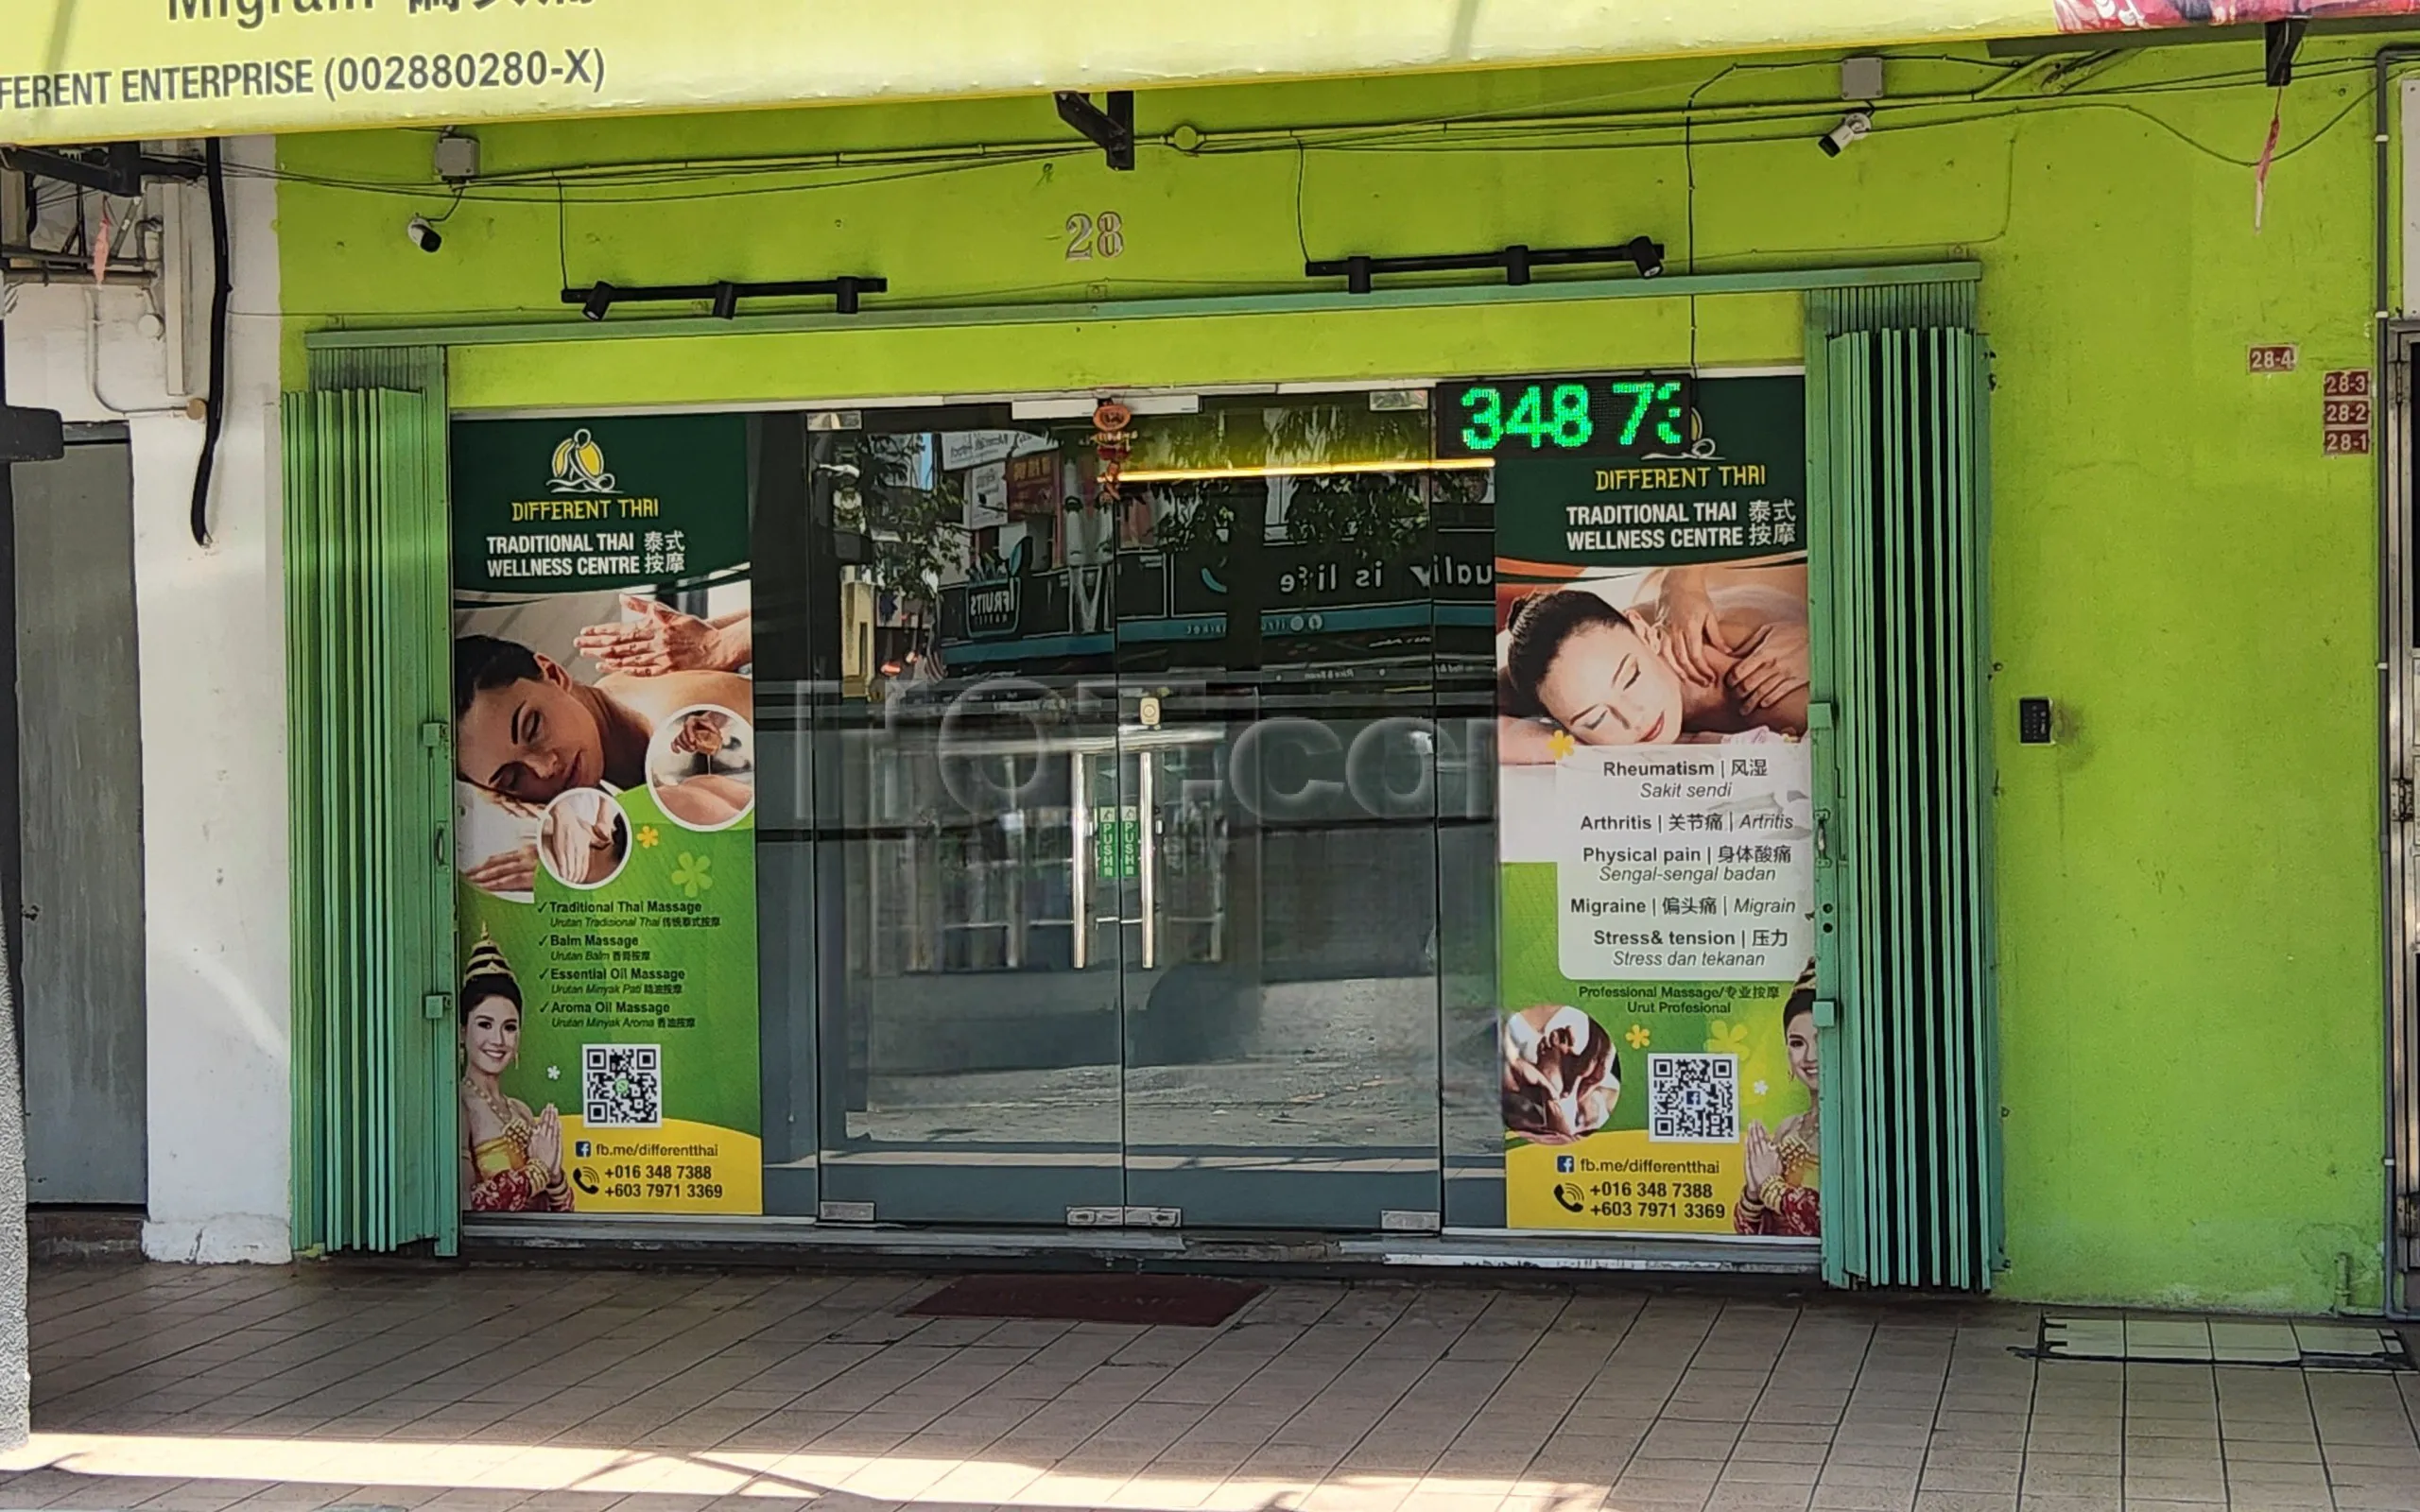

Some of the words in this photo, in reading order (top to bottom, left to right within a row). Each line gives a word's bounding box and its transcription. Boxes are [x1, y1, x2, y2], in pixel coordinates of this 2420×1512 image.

[122, 59, 314, 102] ENTERPRISE
[324, 48, 606, 101] (002880280-X)
[1065, 210, 1124, 261] 28
[2251, 350, 2292, 369] 28-4
[2326, 375, 2366, 393] 28-3
[1461, 384, 1593, 451] 348
[2326, 404, 2367, 422] 28-2
[2326, 434, 2367, 452] 28-1
[1595, 466, 1712, 491] DIFFERENT
[511, 499, 612, 522] DIFFERENT
[1566, 503, 1689, 525] TRADITIONAL
[1693, 501, 1737, 522] THAI
[1749, 499, 1796, 523] 泰式
[487, 534, 593, 555] TRADITIONAL
[596, 531, 634, 551] THAI
[644, 530, 685, 551] 泰式
[1566, 527, 1665, 551] WELLNESS
[1670, 525, 1743, 547] CENTRE
[1749, 523, 1796, 546] 按摩
[487, 558, 573, 577] WELLNESS
[577, 556, 640, 576] CENTRE
[644, 552, 685, 575] 按摩
[1603, 762, 1715, 778] Rheumatism
[1731, 759, 1768, 778] 风湿
[1640, 782, 1682, 799] Sakit
[1686, 782, 1732, 799] sendi
[1581, 814, 1652, 831] Arthritis
[1668, 814, 1723, 832] 关节痛
[1738, 814, 1793, 830] Artritis
[1102, 822, 1115, 867] PUSH
[1124, 821, 1135, 866] PUSH
[1582, 847, 1657, 865] Physical
[1664, 847, 1701, 865] pain
[1718, 845, 1791, 864] 身体酸痛
[1599, 866, 1719, 885] Sengal-sengal
[1723, 866, 1775, 881] badan
[549, 901, 614, 913] Traditional
[617, 901, 644, 913] Thai
[648, 901, 701, 915] Massage
[1570, 899, 1646, 918] Migraine
[1662, 897, 1717, 916] 偏头痛
[1734, 898, 1796, 918] Migrain
[550, 934, 582, 946] Balm
[585, 934, 639, 949] Massage
[1593, 929, 1663, 945] Stress&
[1668, 929, 1736, 945] tension
[1752, 929, 1789, 948] 压力
[1613, 951, 1663, 967] Stress
[1666, 951, 1697, 967] dan
[1702, 951, 1765, 967] tekanan
[551, 968, 607, 980] Essential
[610, 968, 628, 980] Oil
[631, 968, 685, 982] Massage
[1579, 986, 1657, 998] Professional
[551, 1002, 592, 1014] Aroma
[595, 1002, 613, 1014] Oil
[615, 1002, 670, 1016] Massage
[1627, 1002, 1655, 1014] Urut
[1659, 1001, 1731, 1014] Profesional
[596, 1143, 718, 1157] fb.me/differentthai
[605, 1165, 641, 1179] +016
[646, 1165, 672, 1179] 348
[677, 1164, 712, 1179] 7388
[1581, 1158, 1720, 1175] fb.me/differentthai
[605, 1183, 641, 1197] +603
[647, 1183, 681, 1197] 7971
[687, 1183, 723, 1198] 3369
[1590, 1181, 1633, 1196] +016
[1636, 1182, 1668, 1197] 348
[1672, 1182, 1713, 1198] 7388
[1590, 1201, 1633, 1217] +603
[1638, 1201, 1677, 1217] 7971
[1684, 1202, 1725, 1219] 3369
